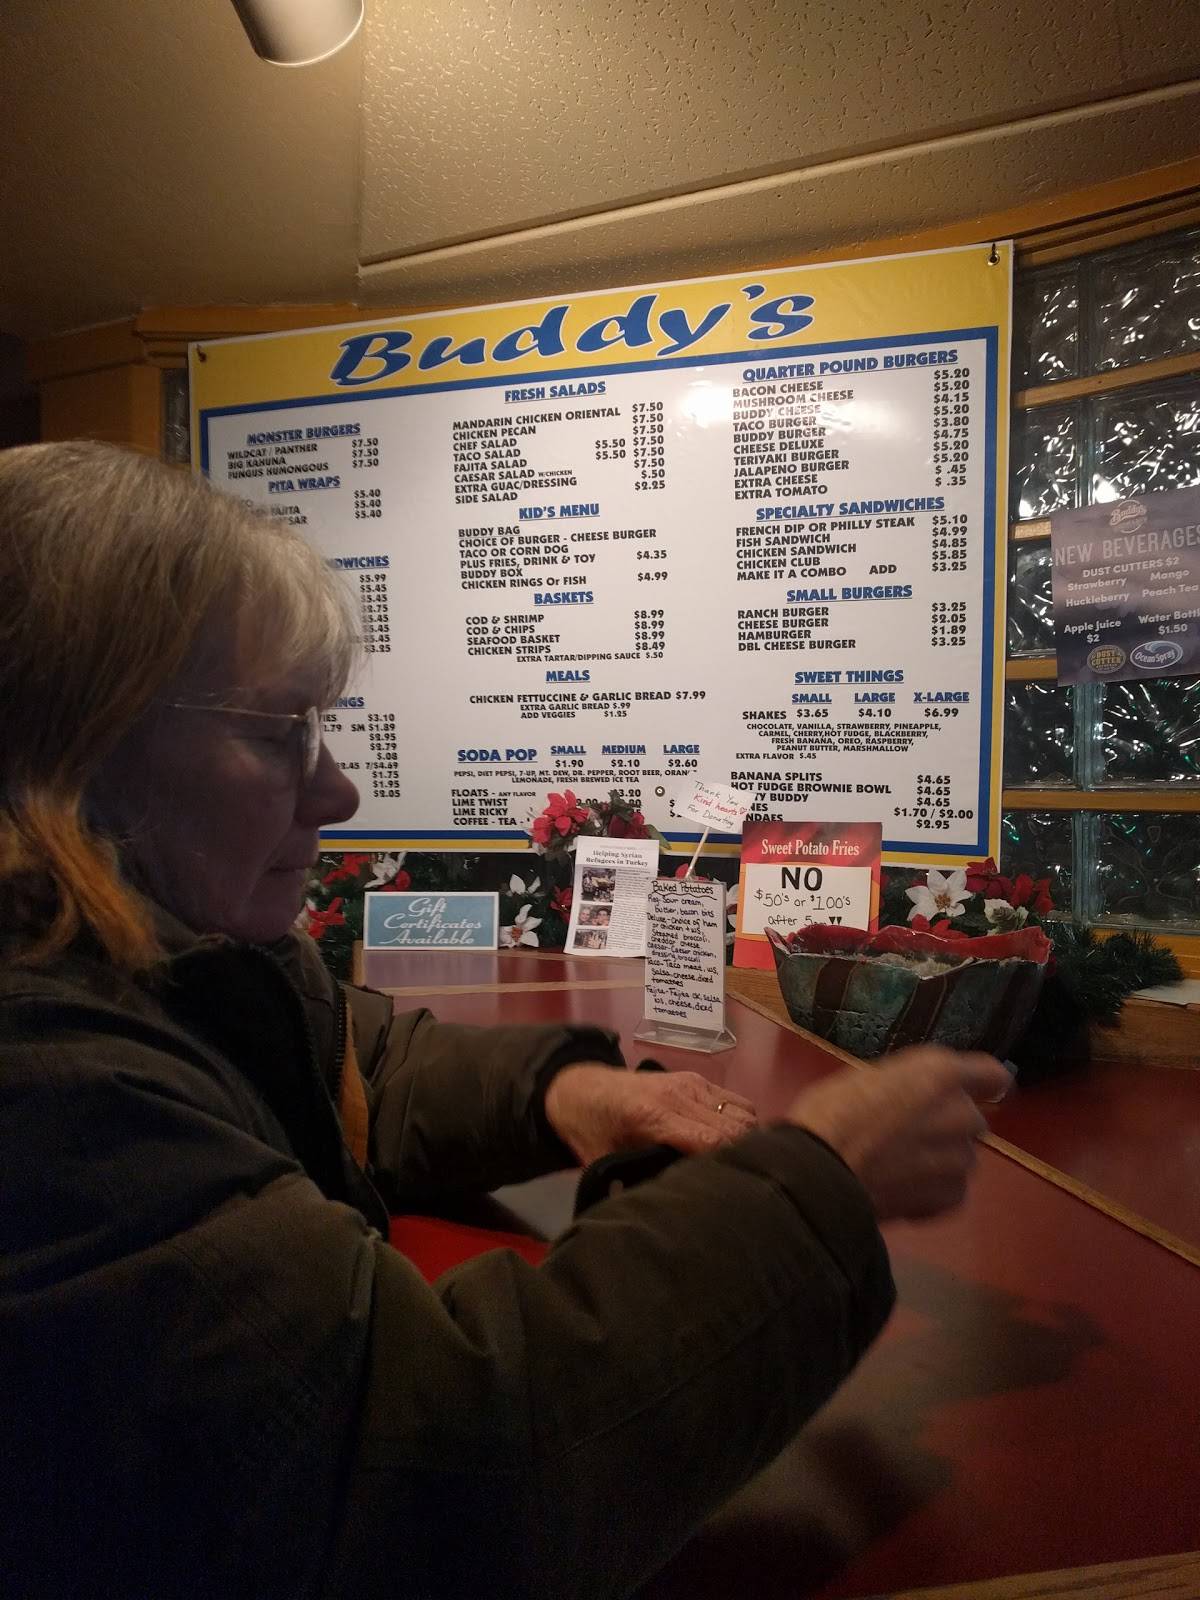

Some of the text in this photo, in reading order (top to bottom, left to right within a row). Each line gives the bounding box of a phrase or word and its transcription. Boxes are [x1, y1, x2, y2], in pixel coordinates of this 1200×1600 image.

[329, 283, 816, 387] Buddy's
[743, 350, 958, 382] QUARTER POUND BURGERS
[733, 368, 969, 397] BACON CHEESE $5.20
[504, 381, 606, 401] FRESH SALADS
[453, 402, 663, 430] MANDARIN CHICKEN ORIENTAL $7.50
[247, 423, 360, 444] MONSTER BURGERS
[453, 425, 663, 450] CHEF SALAD $7.50
[227, 448, 266, 460] WILDCAT
[275, 444, 317, 455] PANTHER
[352, 438, 378, 448] $7.50
[453, 436, 664, 461] TACO SALAD $5.50 $7.50
[734, 440, 969, 466] TERIYAKI BURGER $5.20
[454, 472, 495, 483] CAESAR
[499, 469, 535, 480] SALAD
[634, 458, 664, 468] $7.50
[268, 476, 340, 492] PITA WRAPS
[455, 469, 665, 493] EXTRA GUAC/DRESSING $.50
[354, 489, 381, 499] $5.40
[519, 504, 600, 519] KID'S MENU
[756, 497, 944, 520] SPECIALTY SANDWICHES
[736, 514, 968, 536] FRENCH DIP OR PHILLY STEAK $5.10
[460, 550, 667, 568] PLUS FRIES, DRINK & TOY $4.35
[1055, 544, 1092, 566] NEW
[1083, 557, 1180, 578] DUST CUTTERS $2
[1151, 569, 1189, 581] Mango
[360, 574, 386, 582] $5.99
[1068, 577, 1126, 591] Strawberry
[534, 591, 594, 604] BASKETS
[787, 585, 912, 601] SMALL BURGERS
[1142, 585, 1198, 598] Peach Tea
[1066, 593, 1130, 607] Huckleberry
[466, 610, 664, 625] COD & SHRIMP $8.99
[738, 602, 966, 619] RANCH BURGER $3.25
[1138, 614, 1171, 624] Water
[738, 625, 966, 641] HAMBURGER $1.89
[1064, 623, 1093, 634] Apple
[1158, 624, 1187, 635] $1.50
[1087, 634, 1100, 643] $2
[468, 642, 665, 656] CHICKEN STRIPS $8.49
[546, 670, 590, 682] MEALS
[795, 670, 904, 683] SWEET THINGS
[470, 691, 706, 704] CHICKEN FETTUCCINE & GARLIC BREAD $7.99
[742, 708, 958, 720] SHAKES $3.65 $4.10 $6.99
[458, 749, 537, 762] SODA POP
[731, 772, 950, 785] BANANA SPLITS $4.65
[731, 782, 950, 796] HOT FUDGE BROWNIE BOWL $4.65
[621, 851, 642, 859] Syrian
[762, 839, 860, 856] Sweet Potato Fries
[586, 857, 615, 865] Refugees
[782, 867, 822, 891] NO
[652, 881, 713, 894] Baked Potatoes
[408, 898, 447, 917] Gift
[794, 899, 806, 907] or
[384, 913, 481, 932] Certificates
[768, 915, 797, 925] after
[379, 929, 474, 944] Available
